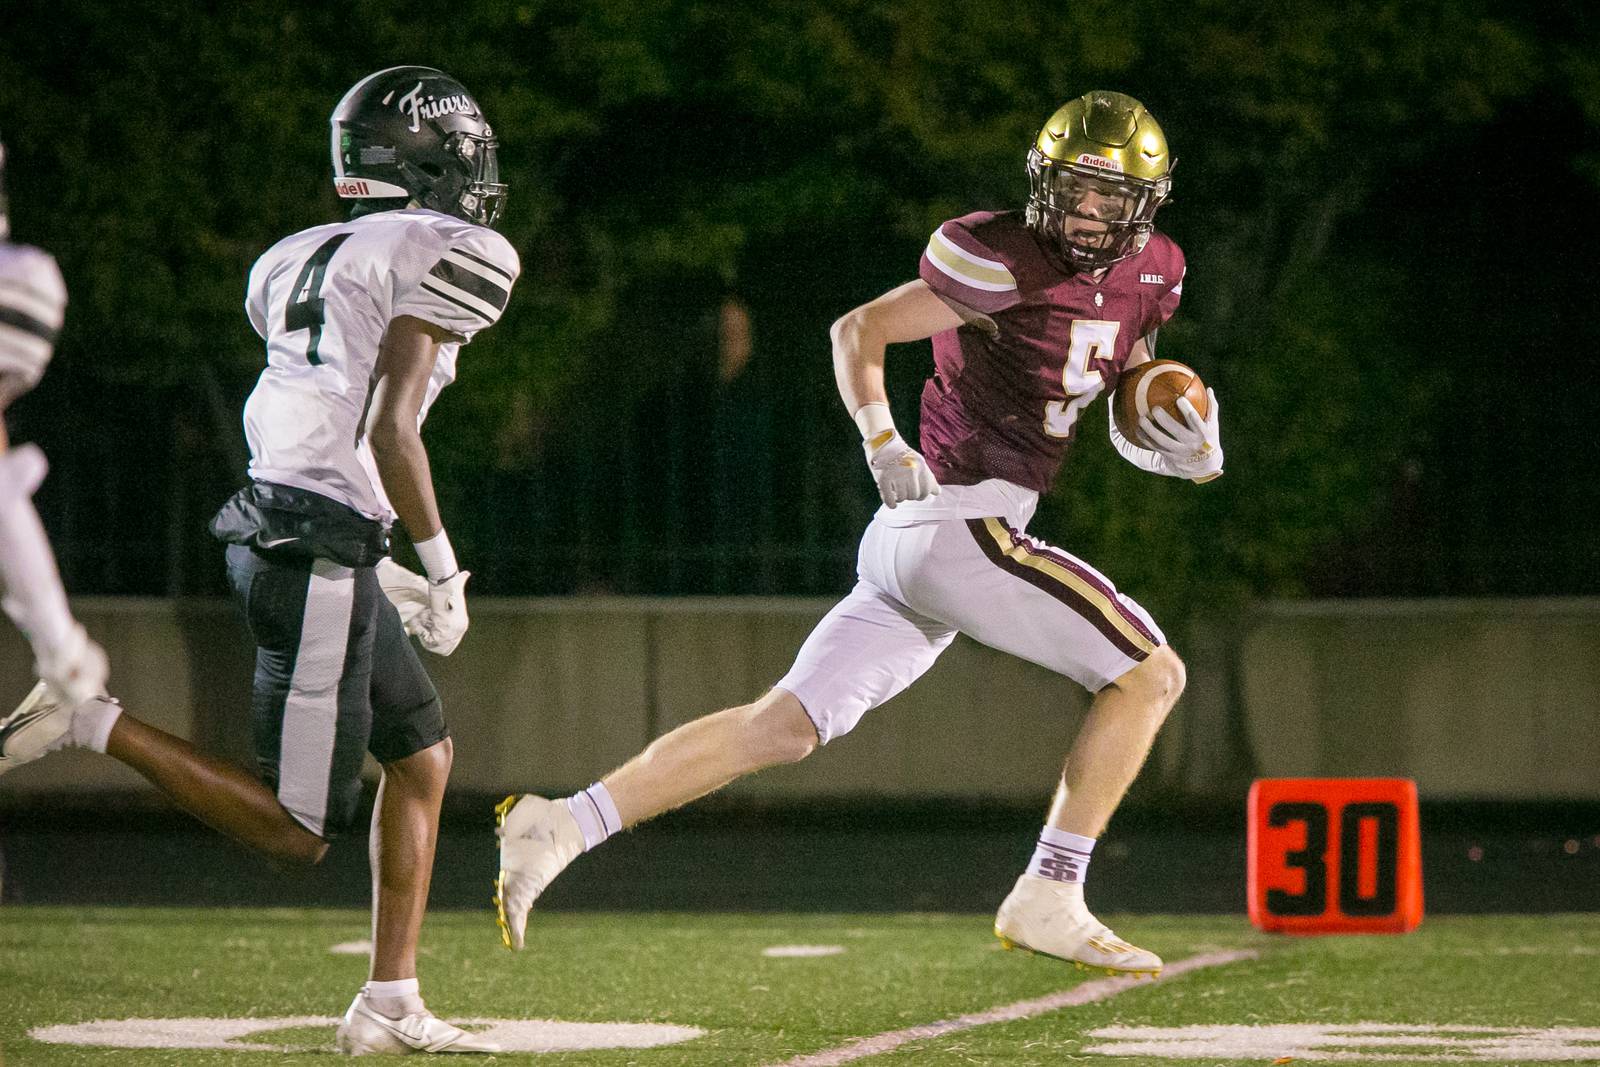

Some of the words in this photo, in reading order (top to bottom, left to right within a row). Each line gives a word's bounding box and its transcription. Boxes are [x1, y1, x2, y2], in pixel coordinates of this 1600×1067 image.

[400, 82, 471, 133] Friars
[1082, 156, 1119, 171] Riddell
[285, 233, 355, 367] 4
[1043, 319, 1120, 438] 5
[1266, 802, 1398, 917] 30
